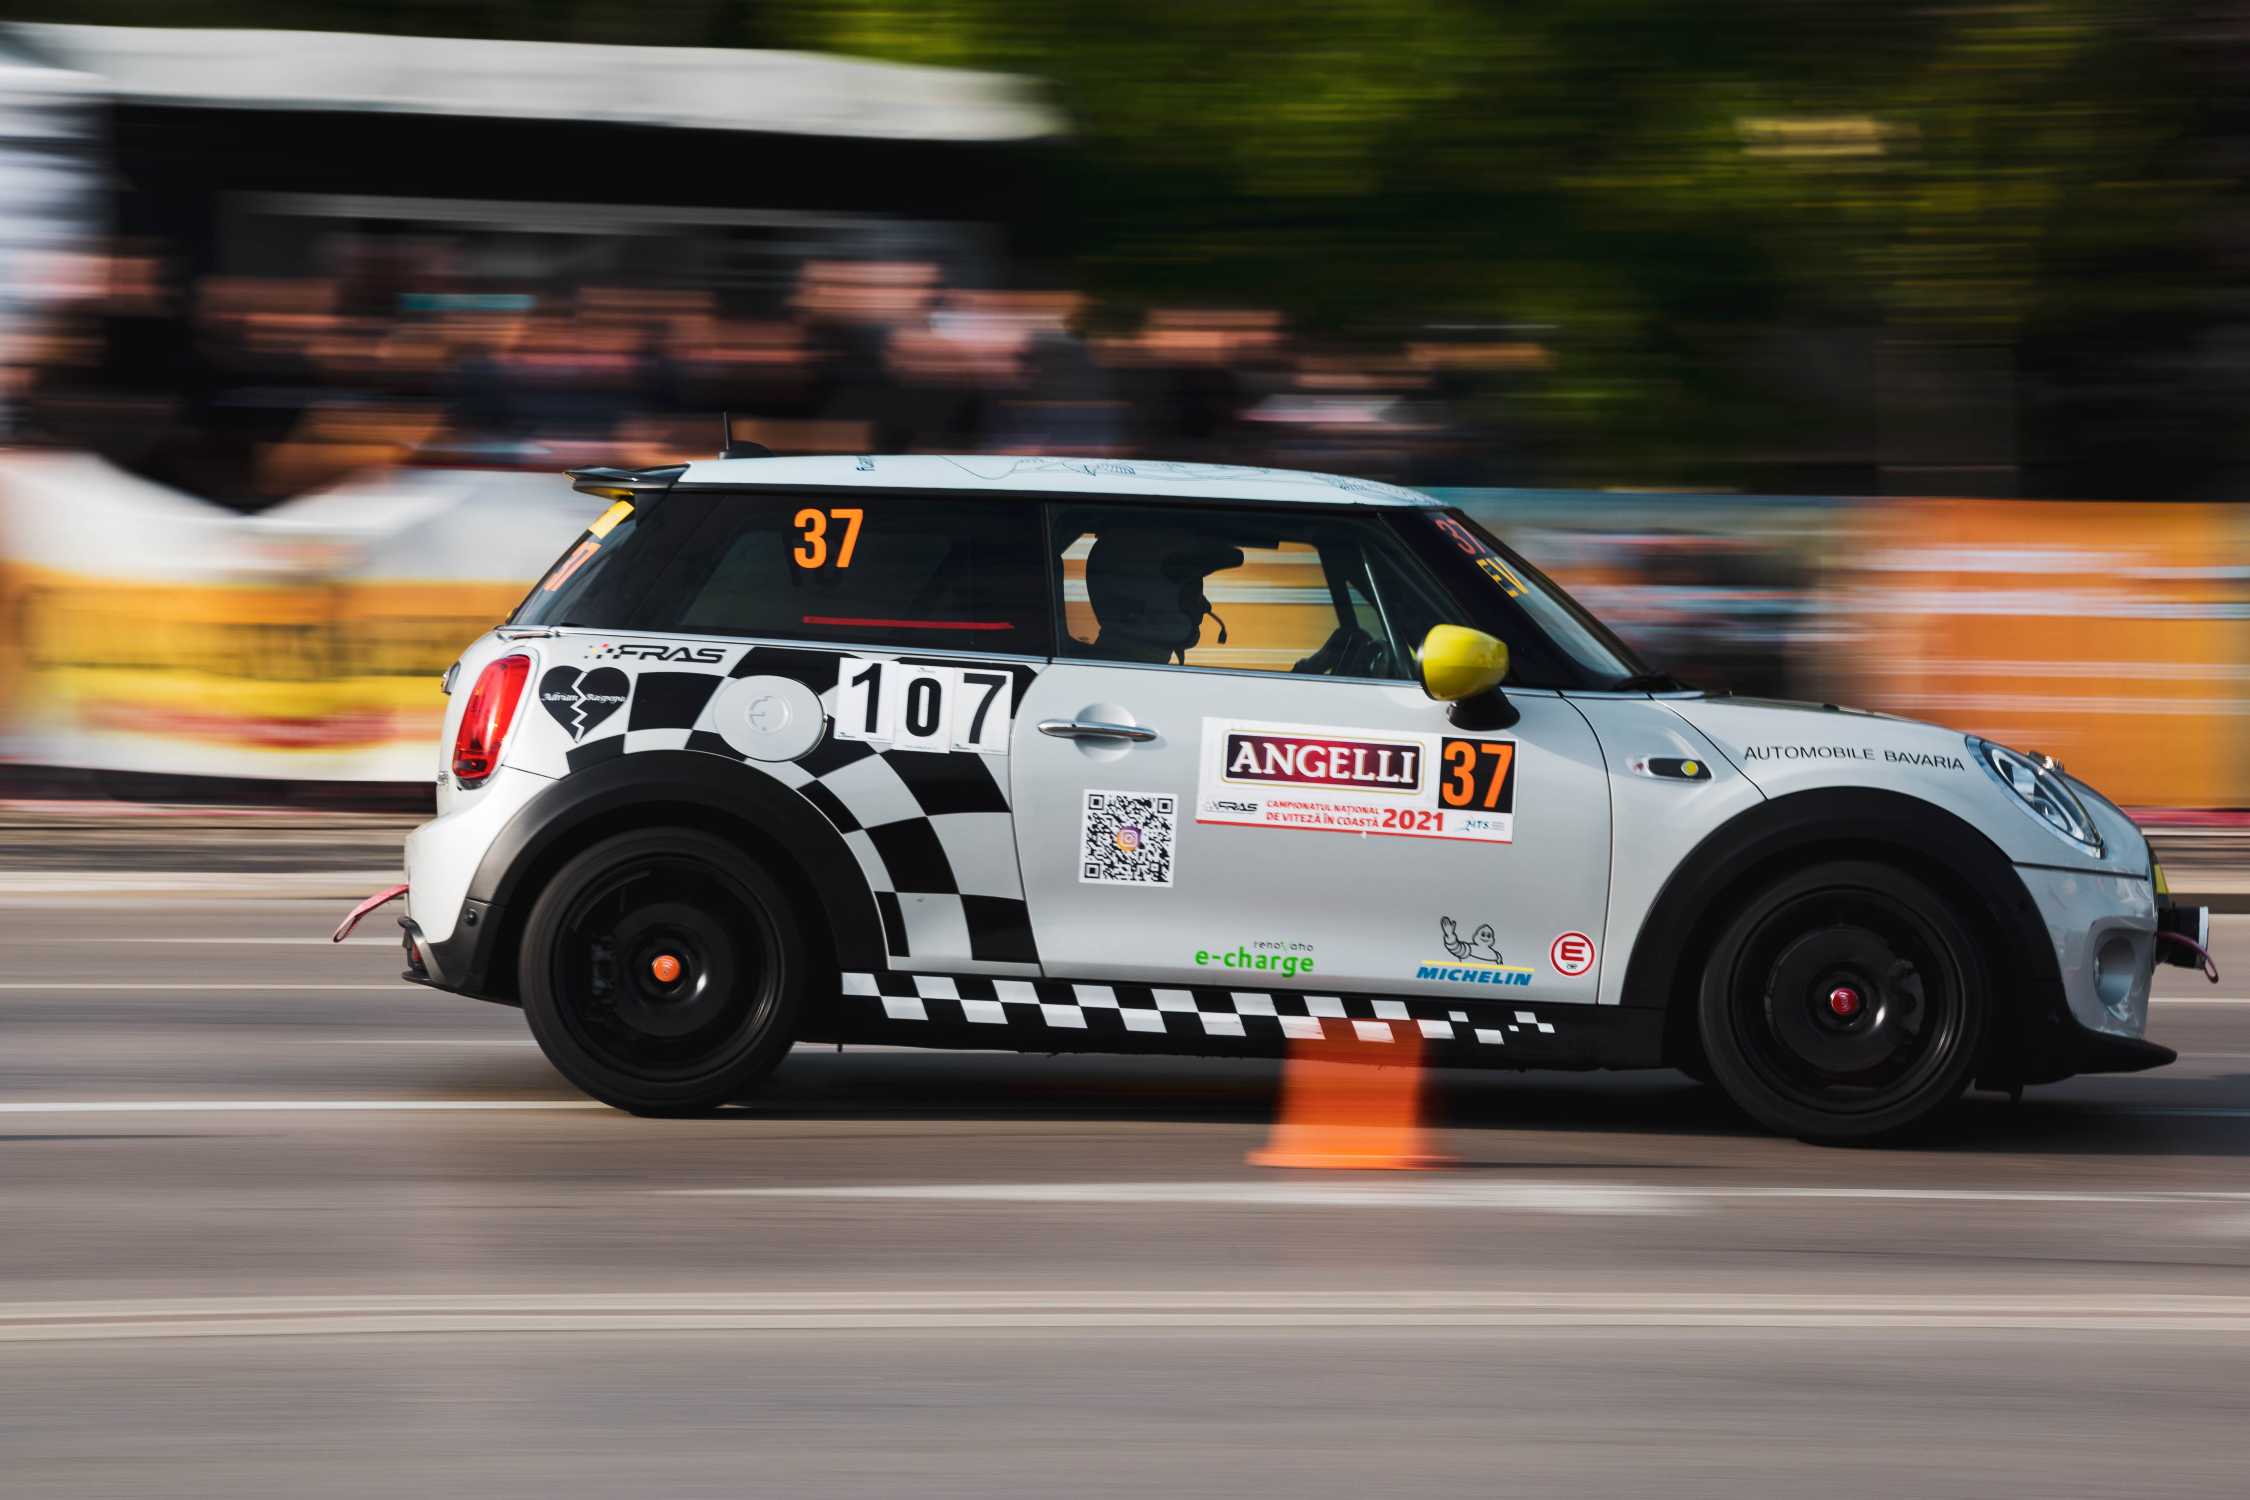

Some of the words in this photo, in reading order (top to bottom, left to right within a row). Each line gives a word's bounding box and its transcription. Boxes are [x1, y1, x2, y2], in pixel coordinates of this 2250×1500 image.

[793, 508, 864, 568] 37
[1434, 518, 1486, 555] 37
[612, 644, 727, 664] FRAS
[851, 662, 1007, 745] 107
[1229, 741, 1417, 784] ANGELLI
[1744, 745, 1876, 761] AUTOMOBILE
[1884, 750, 1965, 771] BAVARIA
[1442, 740, 1513, 808] 37
[1266, 800, 1332, 813] CAMPIONATUL
[1266, 812, 1280, 822] DE
[1382, 808, 1445, 832] 2021
[1194, 946, 1315, 978] e-charge
[1416, 966, 1533, 987] MICHELIN
